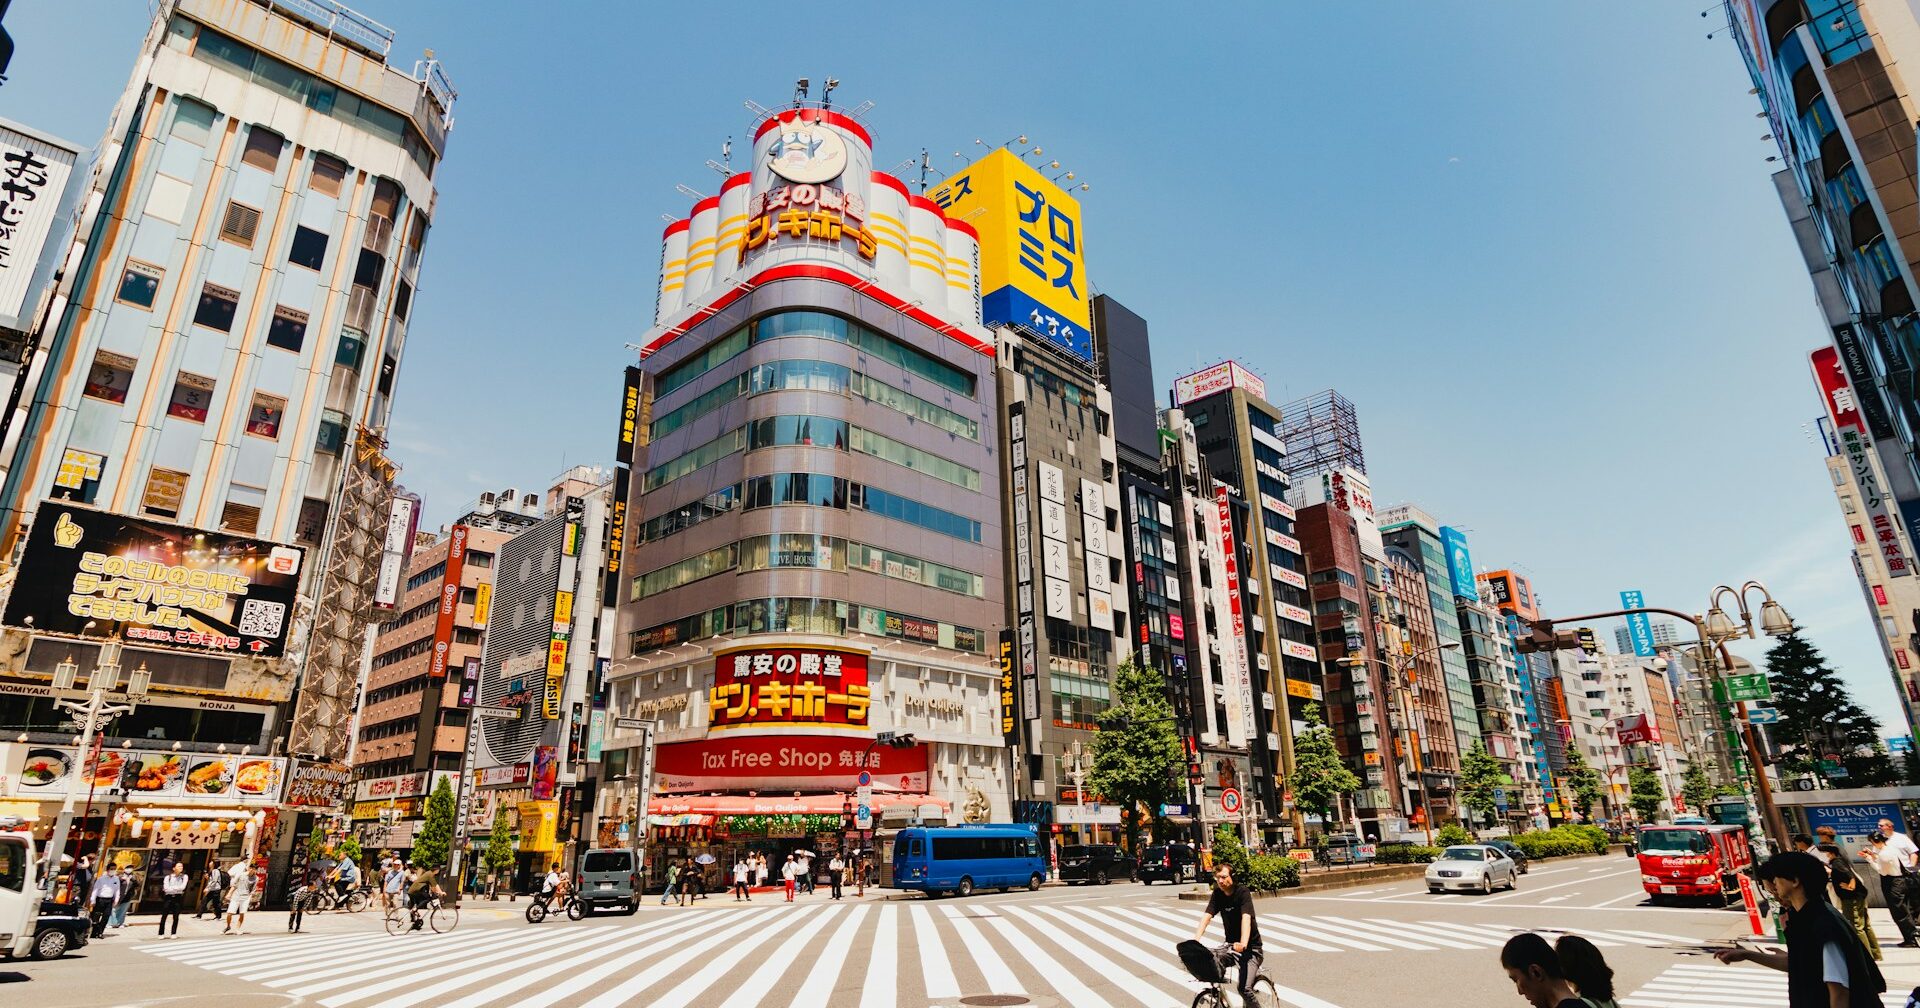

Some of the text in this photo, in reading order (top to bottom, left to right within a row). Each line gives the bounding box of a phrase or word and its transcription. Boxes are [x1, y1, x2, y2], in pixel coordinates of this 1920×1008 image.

[1047, 471, 1064, 613] 北海道レストラン
[1217, 493, 1232, 540] カラオケ
[1226, 553, 1239, 600] パセラ
[773, 554, 816, 565] LIVE HOUSE
[80, 552, 251, 595] このビルの8階に
[73, 573, 227, 612] ライブハウスが
[552, 641, 565, 665] 麻雀
[734, 653, 842, 678] 驚安の殿堂
[0, 684, 50, 696] NOMIYAKI
[547, 677, 559, 716] CASINO
[904, 693, 926, 706] Don
[200, 701, 236, 711] MONJA
[1619, 730, 1644, 742] アコム
[702, 748, 880, 770] Tax Free Shop 免税店
[459, 726, 477, 826] GODZILLA ROAD
[678, 780, 694, 789] Quijote
[293, 781, 342, 799] お好み焼き
[754, 804, 808, 813] Don Quijote
[1817, 806, 1888, 818] SUBNADE
